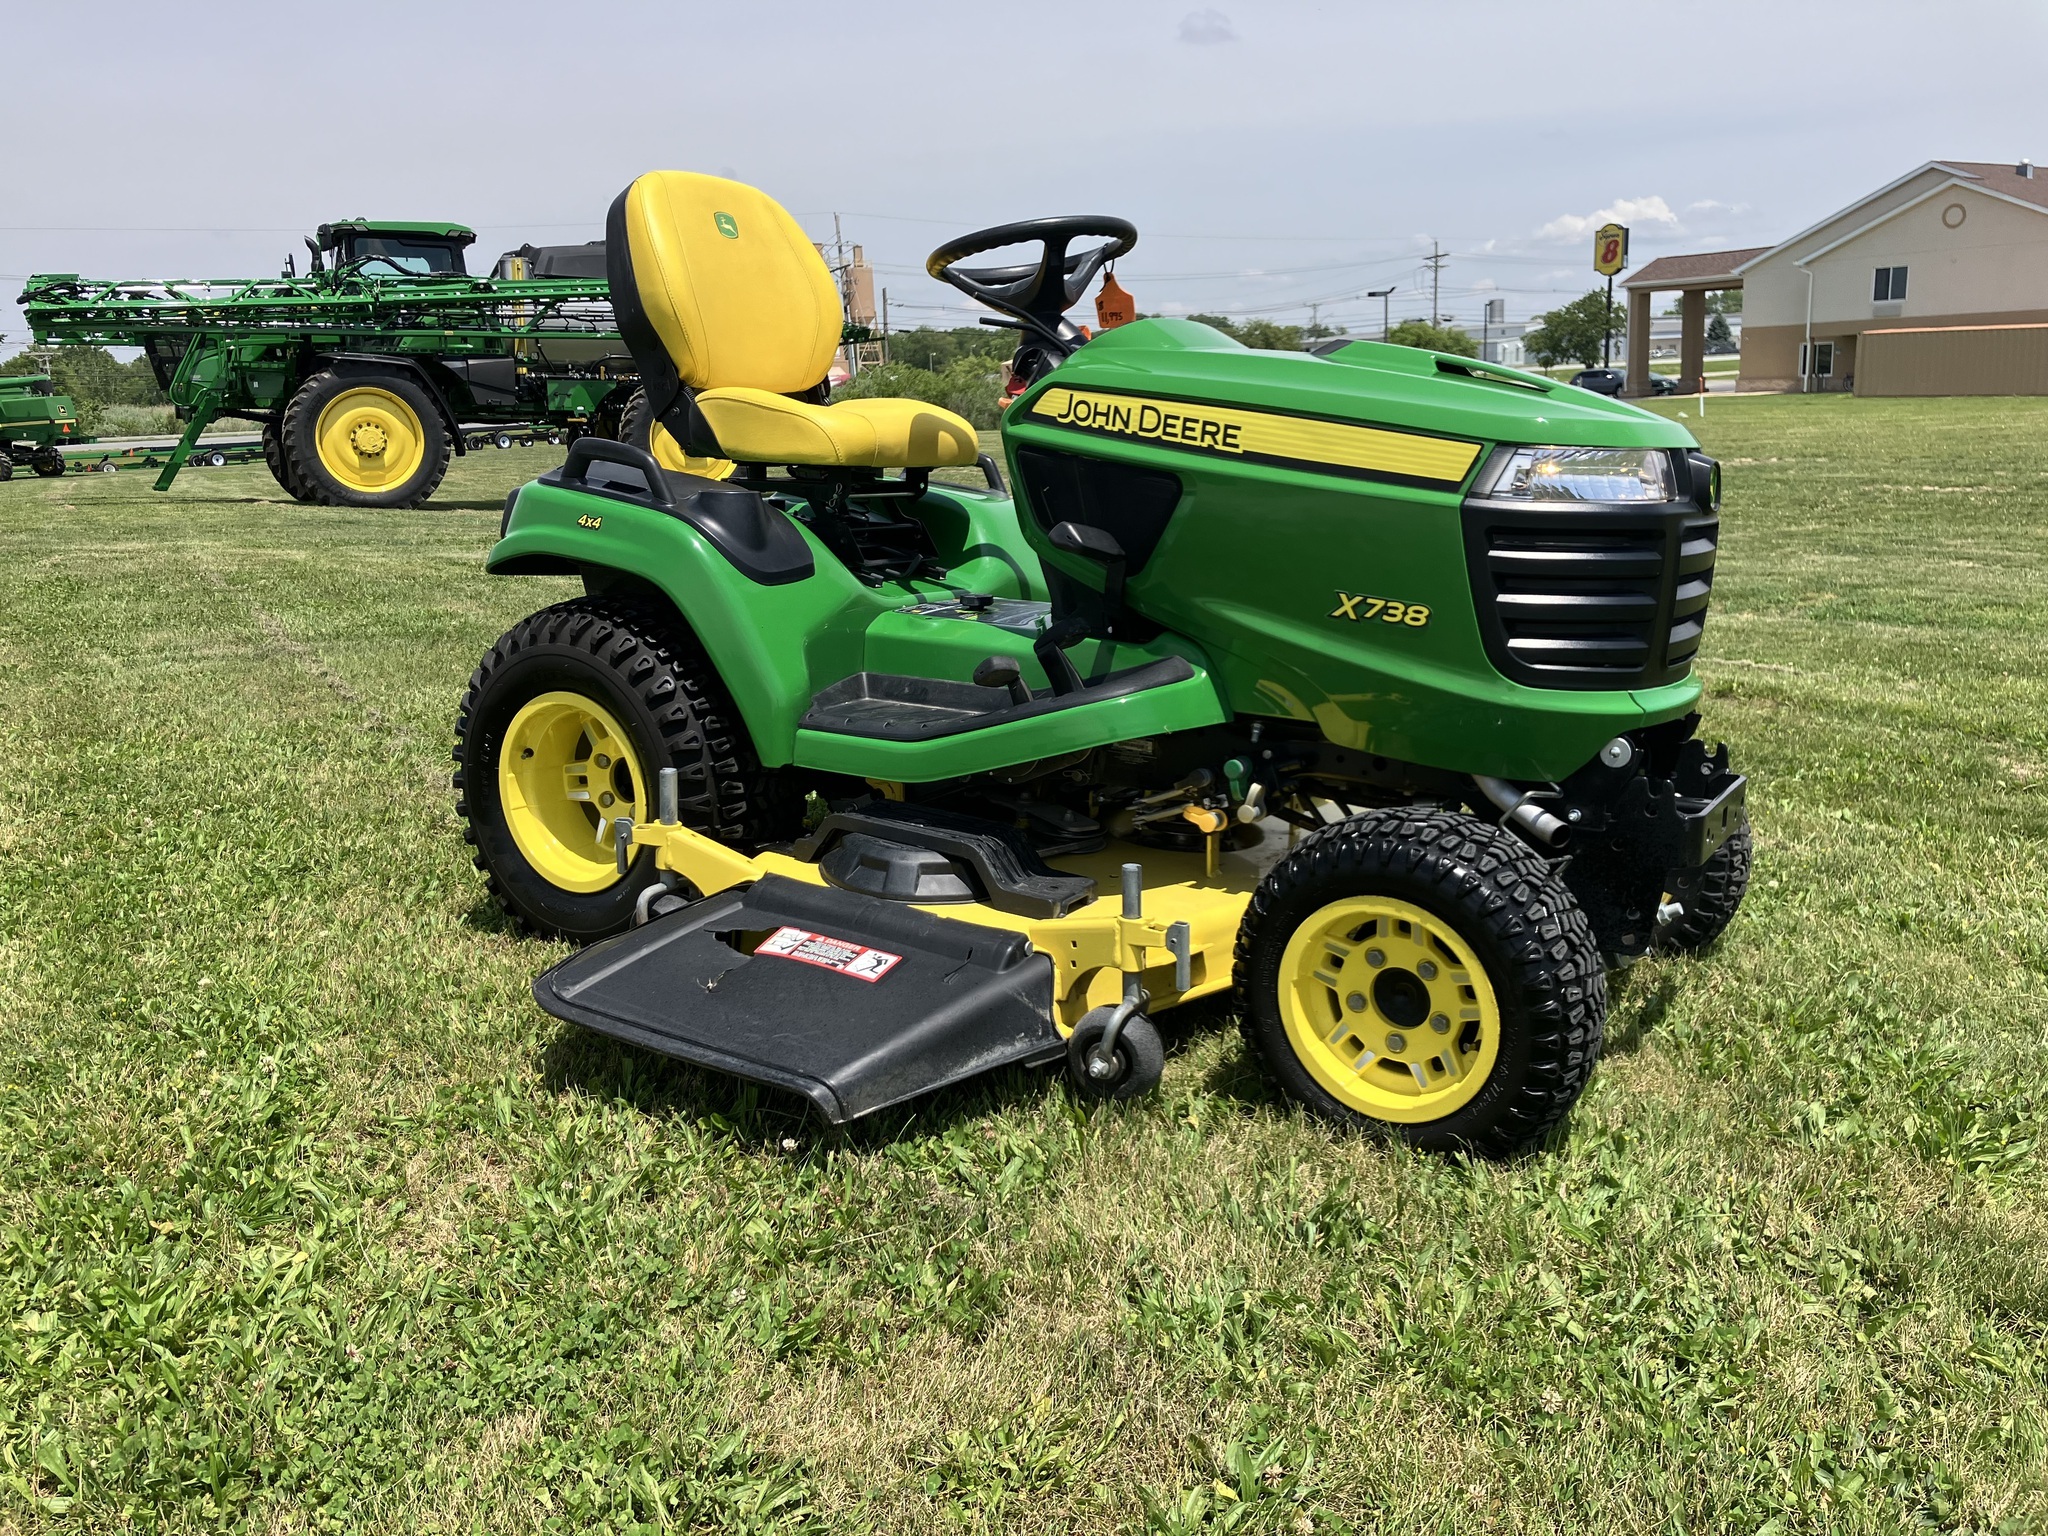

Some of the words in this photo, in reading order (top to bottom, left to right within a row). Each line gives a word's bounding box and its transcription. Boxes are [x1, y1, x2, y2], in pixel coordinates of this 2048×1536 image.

[1602, 239, 1620, 264] 8
[1101, 312, 1123, 325] 11,995
[1057, 393, 1132, 431] JOHN
[1138, 404, 1243, 450] DEERE
[577, 514, 602, 529] 4x4
[1329, 592, 1431, 627] X738
[824, 937, 862, 952] DANGER
